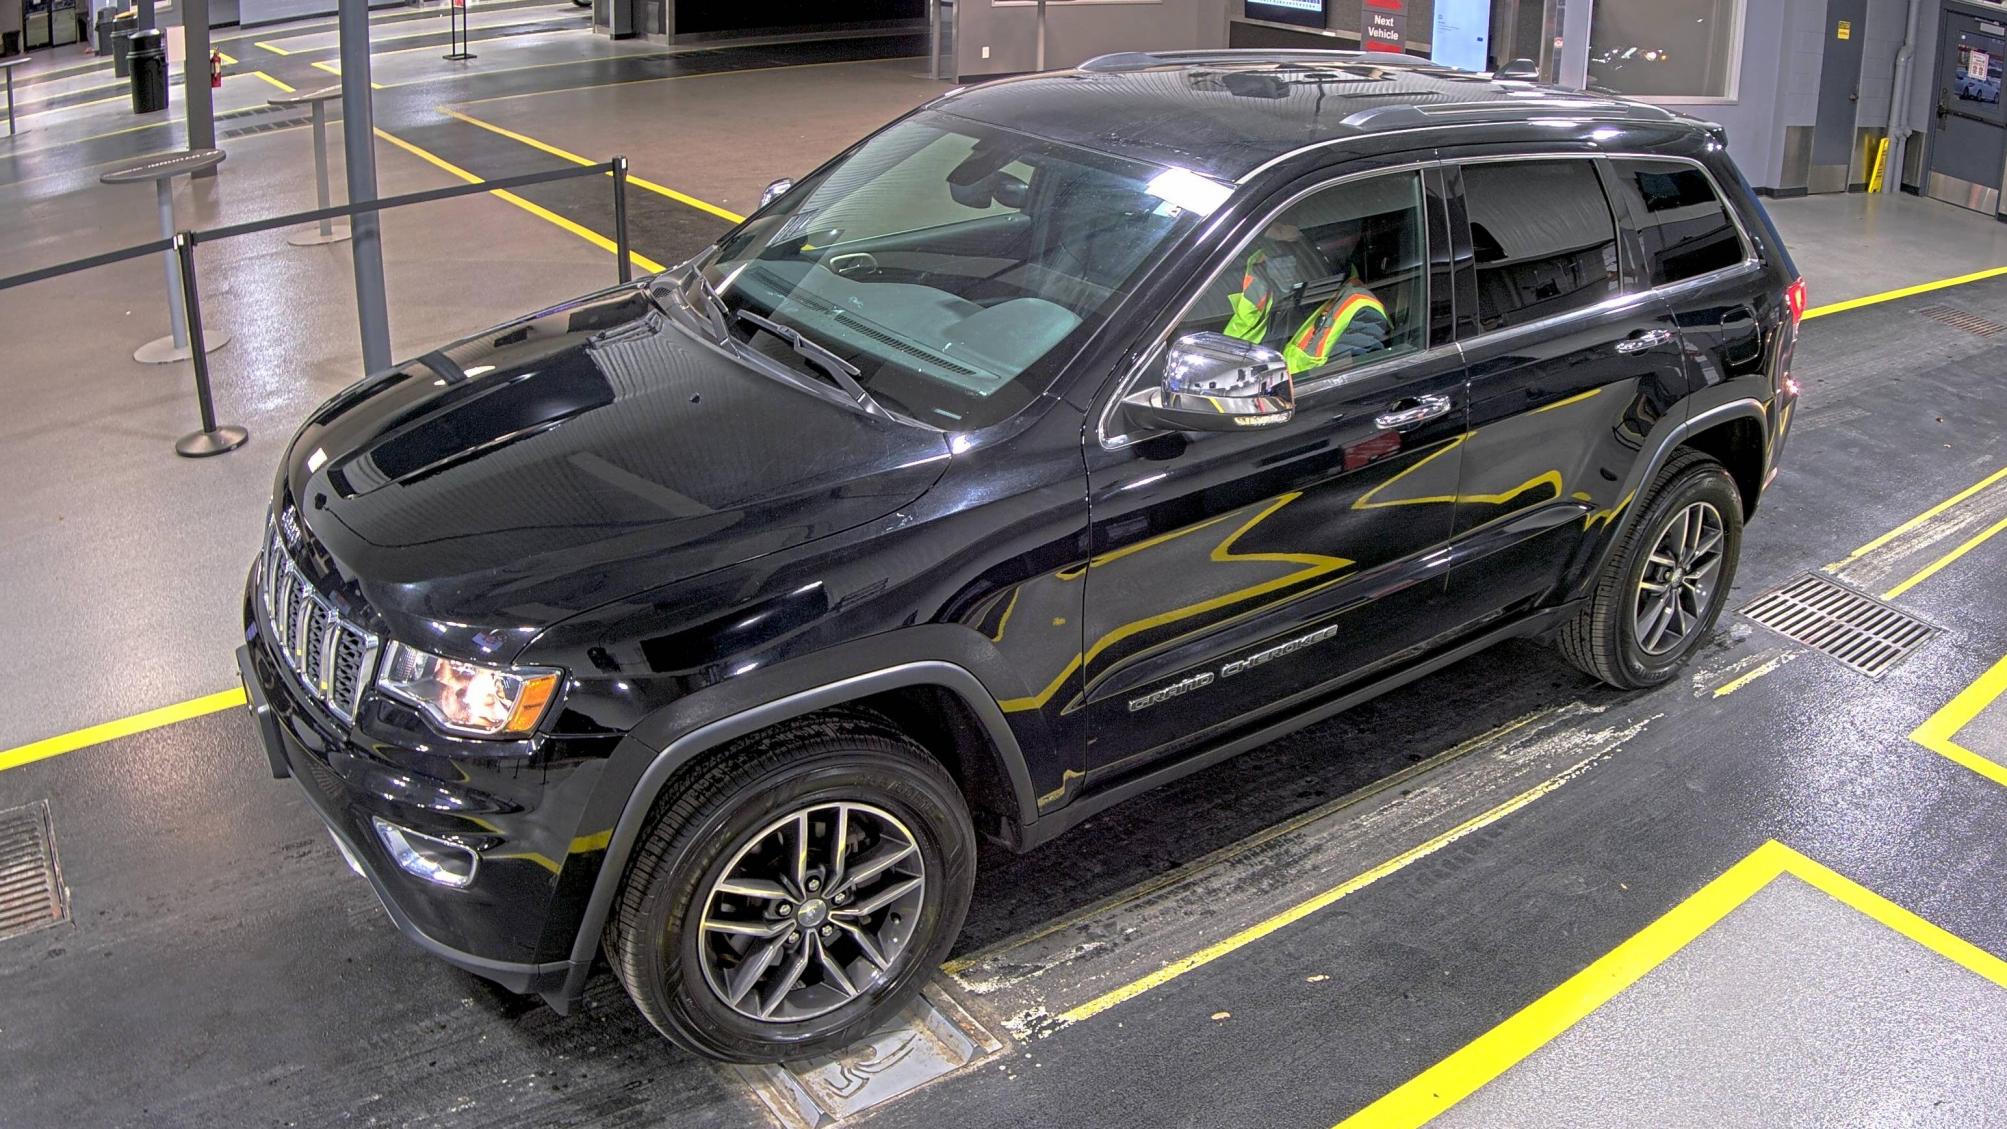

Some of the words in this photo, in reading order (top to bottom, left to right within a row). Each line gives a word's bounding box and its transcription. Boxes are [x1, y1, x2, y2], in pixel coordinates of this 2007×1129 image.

[1374, 15, 1394, 27] Next
[1368, 26, 1399, 40] Vehicle
[1129, 672, 1214, 712] GRAND
[1221, 624, 1338, 678] CHEROKEE
